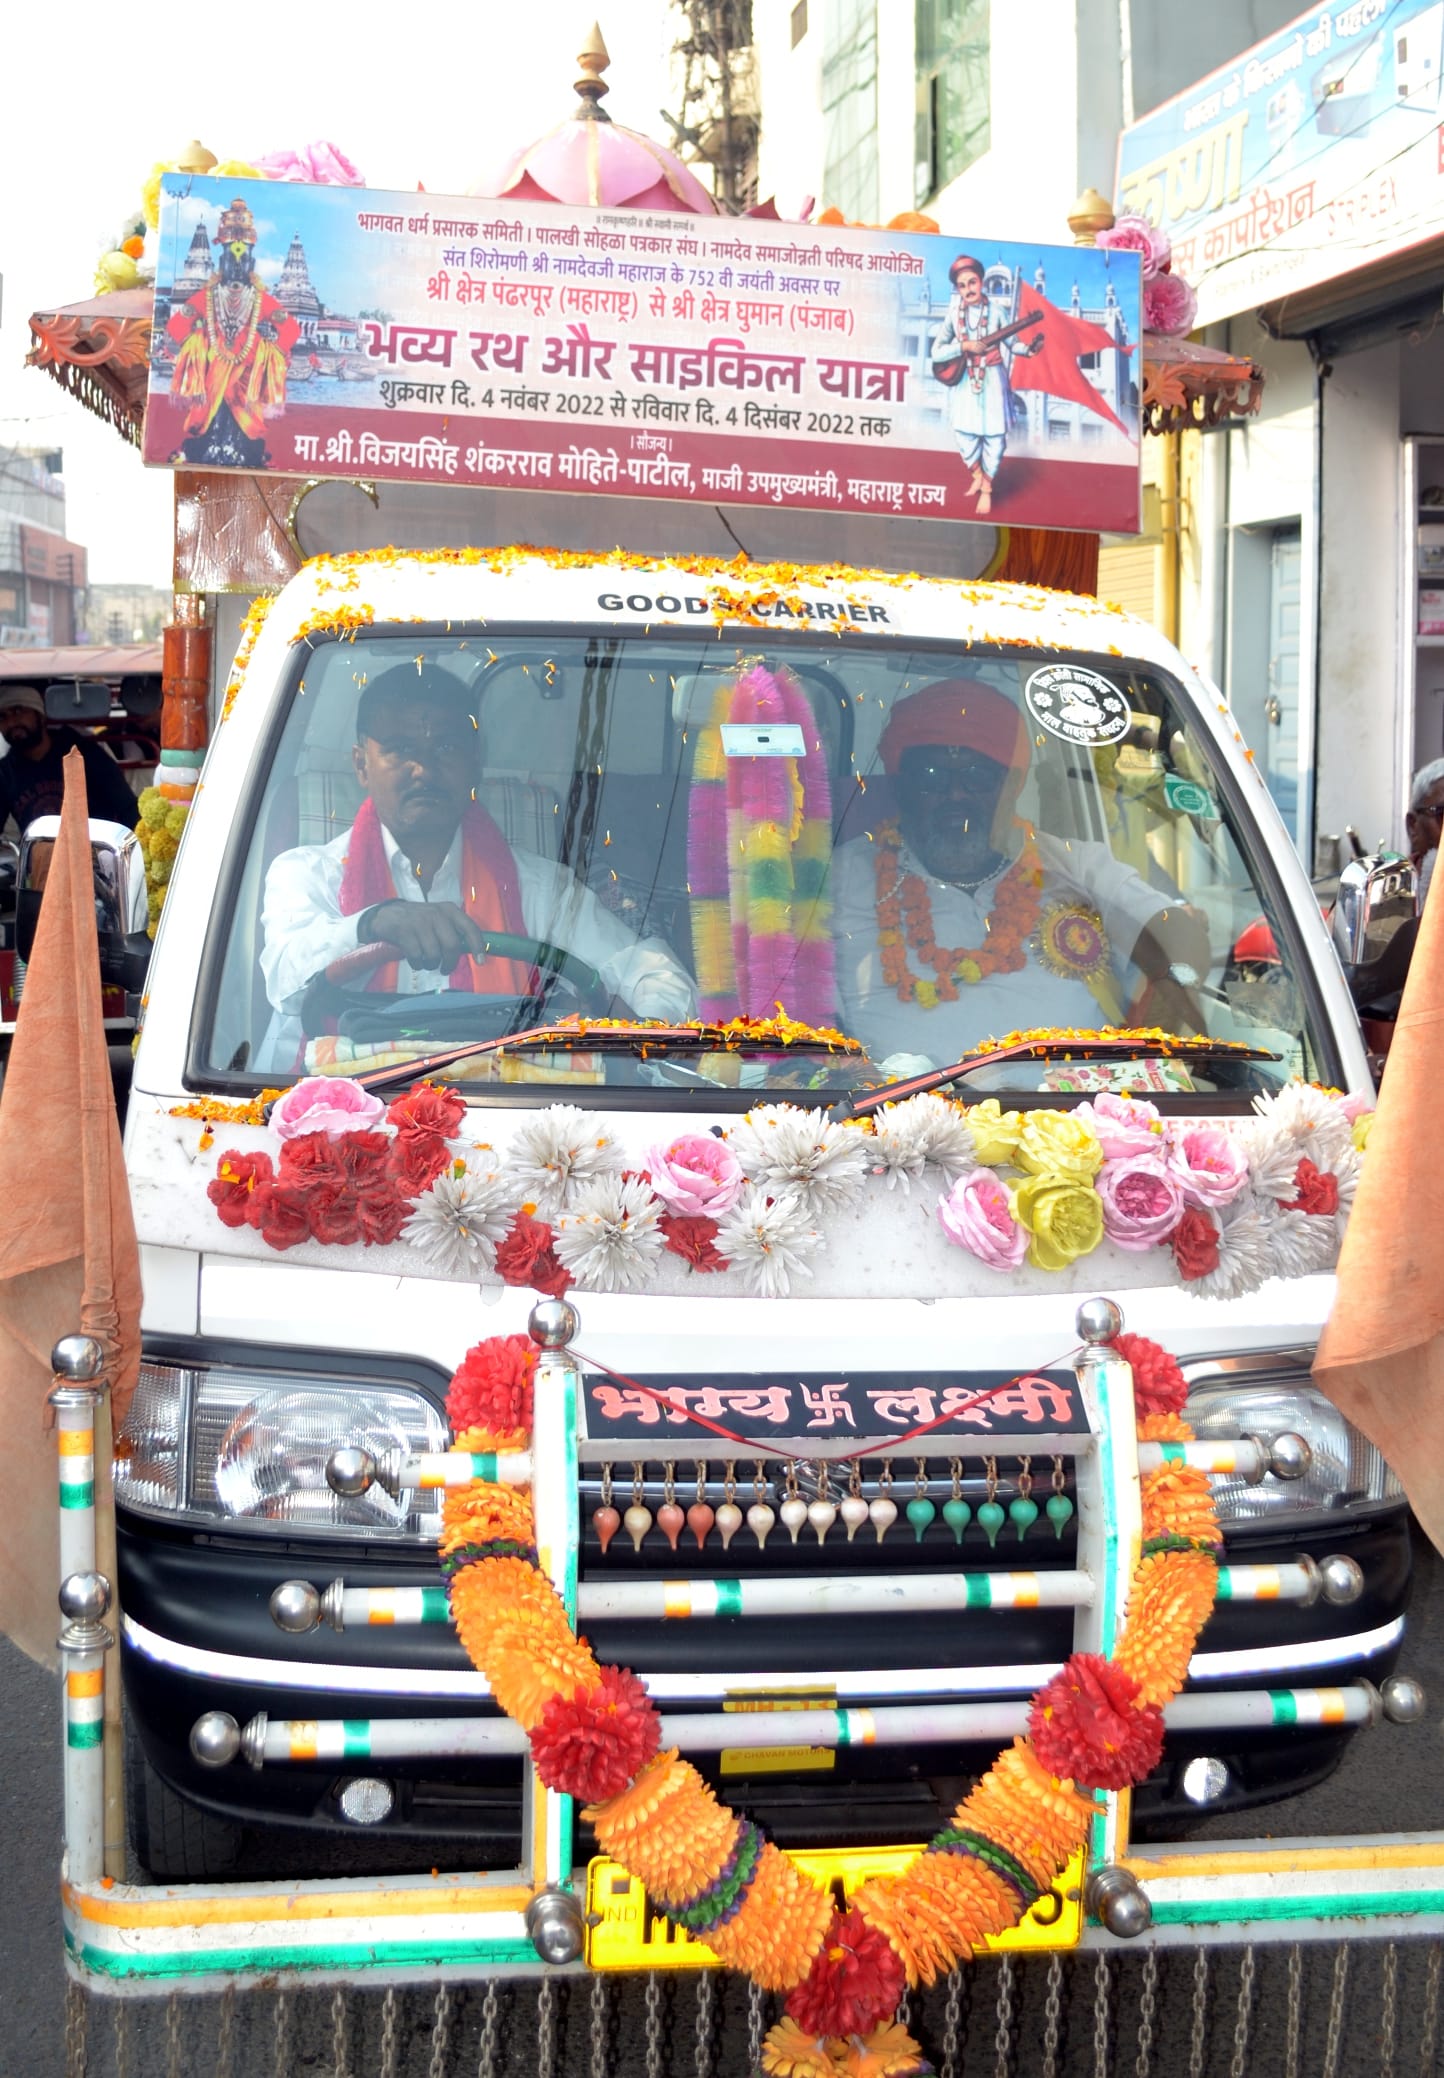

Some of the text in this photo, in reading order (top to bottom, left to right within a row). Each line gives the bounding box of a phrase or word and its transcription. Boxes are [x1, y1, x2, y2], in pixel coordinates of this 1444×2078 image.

[359, 214, 404, 232] भागवत
[408, 212, 429, 235] धर्म
[433, 220, 479, 238] प्रसारक
[483, 219, 523, 242] समिती
[536, 224, 580, 246] पालखी
[584, 226, 626, 251] सोहळा
[630, 235, 672, 254] पत्रकार
[677, 235, 698, 256] संघ
[711, 238, 752, 261] नामदेव
[826, 247, 864, 270] परिषद
[868, 251, 922, 273] आयोजित
[444, 246, 840, 296] संत शिरोमणी श्री नामदेवजी महाराज के 752 वी जयंती अवसर पर
[427, 270, 854, 336] श्री क्षेत्र पंढरपूर (महाराष्ट्र) से श्री क्षेत्र घुमान (पंजाब)
[365, 323, 910, 403] भव्य रथ और साइकिल यात्रा
[380, 379, 891, 438] शुक्रवार दि. 4 नवंबर 2022 से रविवार दि. 4 दिसंबर 2022 तक
[465, 440, 553, 477] शंकरराव
[558, 445, 695, 493] मोहिते-पाटील,
[703, 464, 743, 491] माजी
[748, 469, 842, 502] उपमुख्यमंत्री,
[848, 478, 904, 511] महाराष्ट्र
[908, 482, 946, 507] राज्य
[751, 598, 891, 624] CARRIER
[1040, 711, 1062, 729] माल
[592, 1376, 1074, 1428] भाग्य लक्ष्मी
[744, 1750, 786, 1760] CHAVAN
